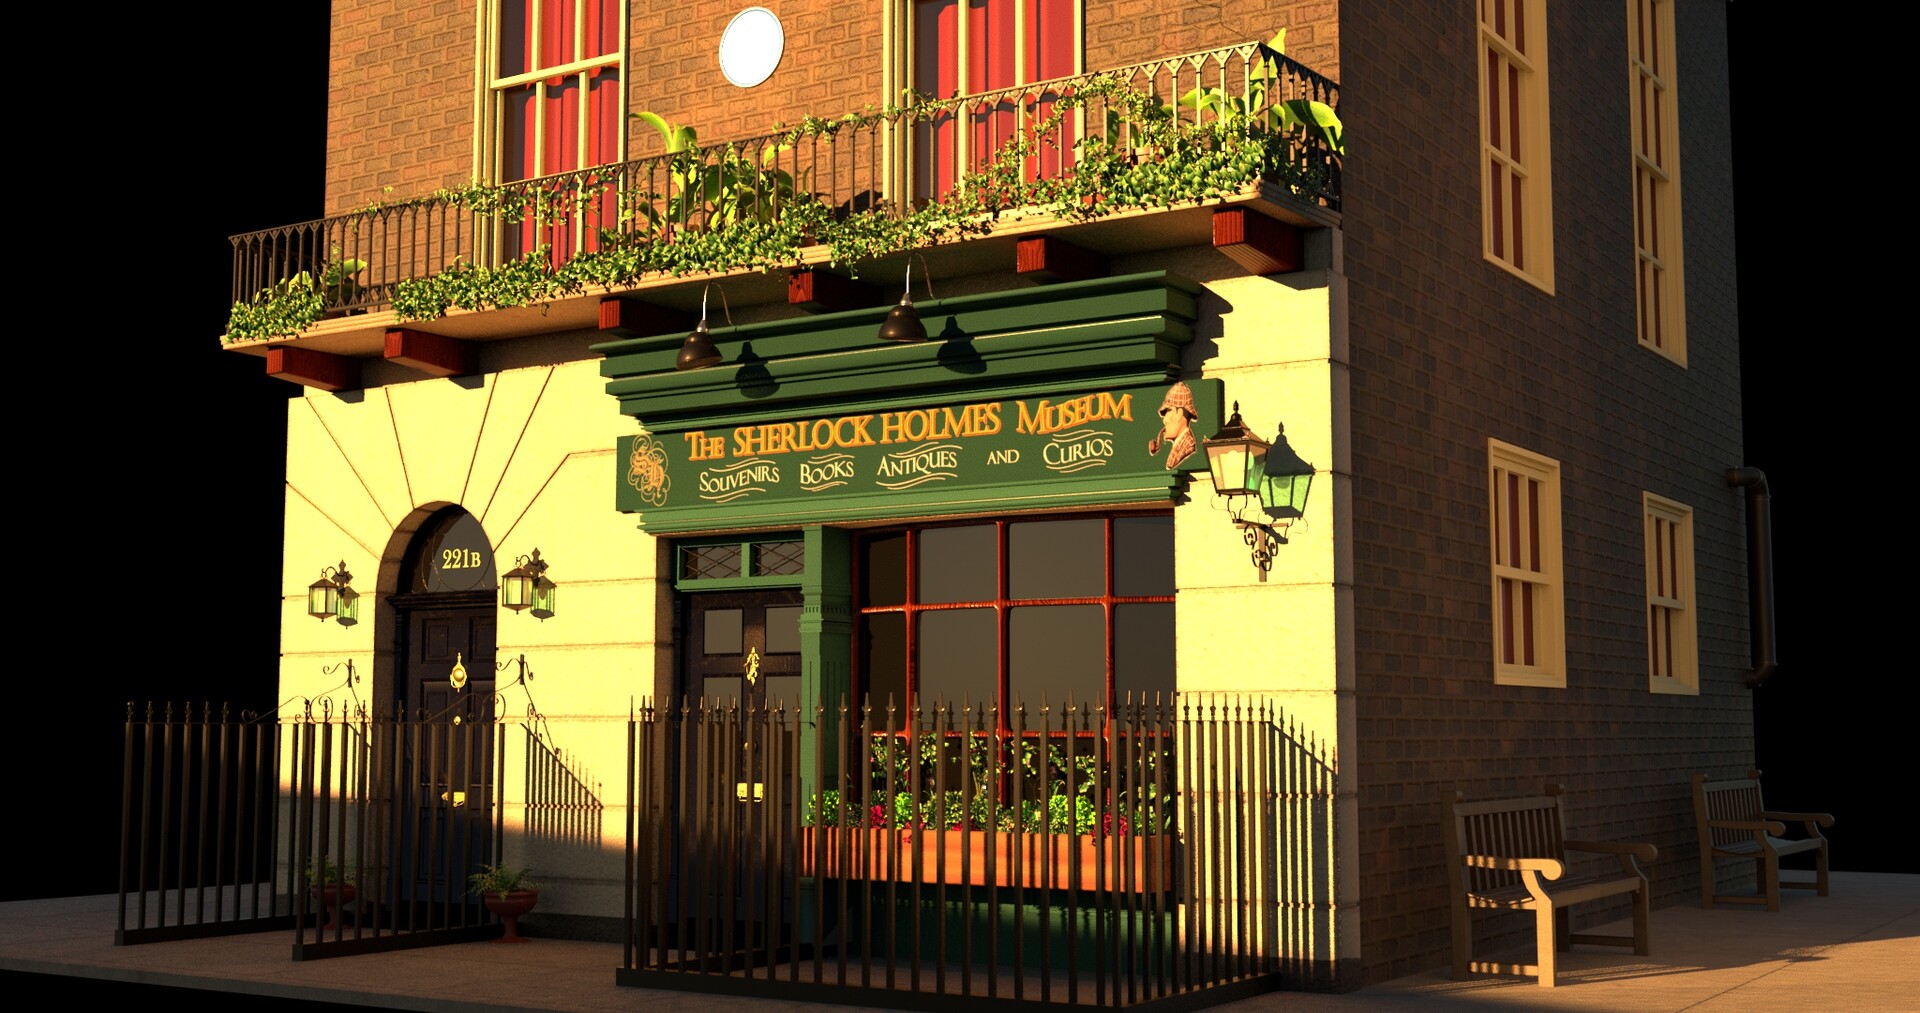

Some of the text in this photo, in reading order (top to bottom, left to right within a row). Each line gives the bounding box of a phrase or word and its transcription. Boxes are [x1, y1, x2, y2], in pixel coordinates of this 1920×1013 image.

[733, 415, 875, 457] SHERLOCK
[880, 403, 1002, 444] HOLMES
[1015, 392, 1133, 435] MUSEUM
[800, 460, 854, 485] BOOKS
[876, 450, 958, 478] ANTIQUES
[1042, 438, 1114, 466] CURIOS
[441, 548, 482, 570] 221B
